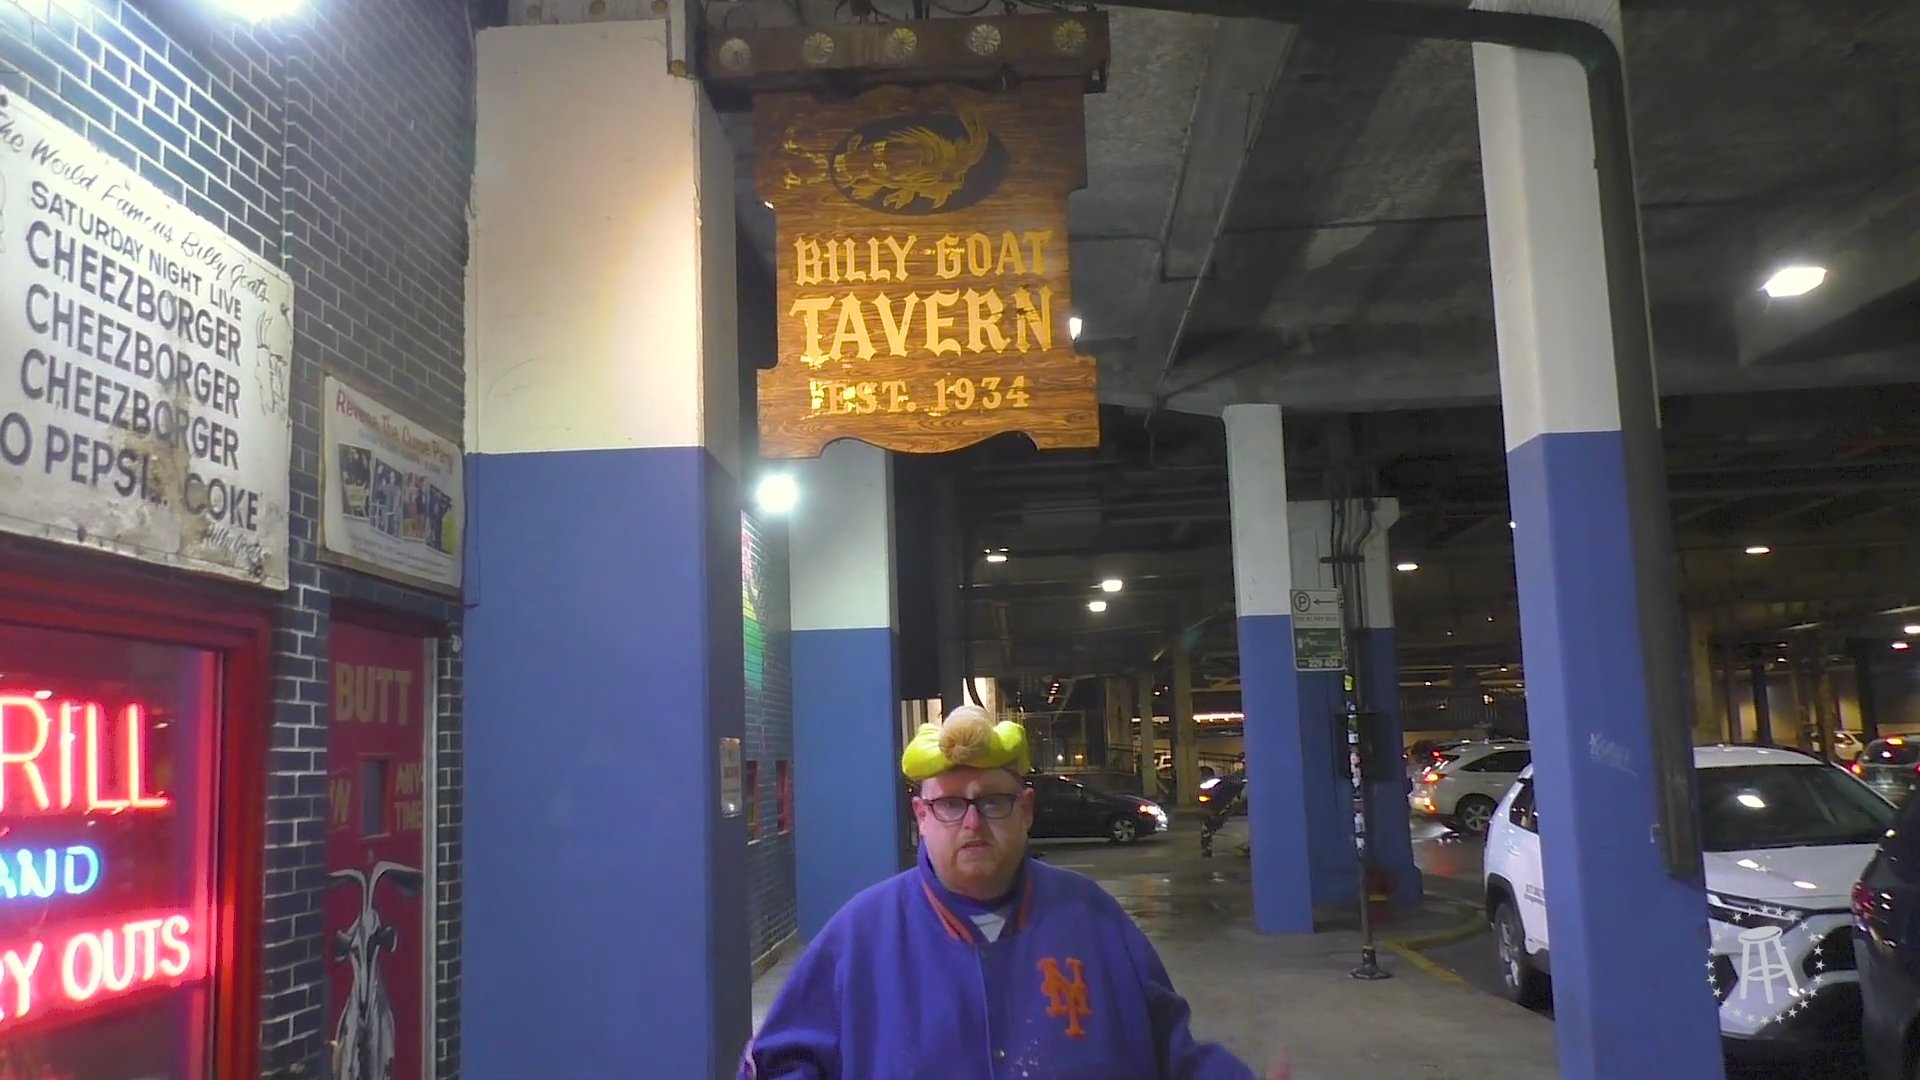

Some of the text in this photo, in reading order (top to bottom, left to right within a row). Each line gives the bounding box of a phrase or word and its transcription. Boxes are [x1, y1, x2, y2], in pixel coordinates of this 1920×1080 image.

[0, 110, 24, 153] he
[31, 138, 99, 192] World
[101, 184, 173, 243] Famous
[181, 231, 228, 281] Billy
[26, 220, 242, 366] CHEEZBORGER
[31, 181, 242, 322] SATURDAY NIGHT LIVE
[793, 230, 1053, 286] BILLY GOAT
[26, 283, 241, 418] CHEEZBORGER
[789, 286, 1053, 362] TAVERN
[21, 348, 239, 470] CHEEZBORGER
[824, 375, 1030, 415] EST. 1934
[184, 472, 259, 531] COKE
[335, 662, 412, 725] BUTT
[393, 801, 424, 832] TIME
[0, 915, 190, 1022] Y OUTS
